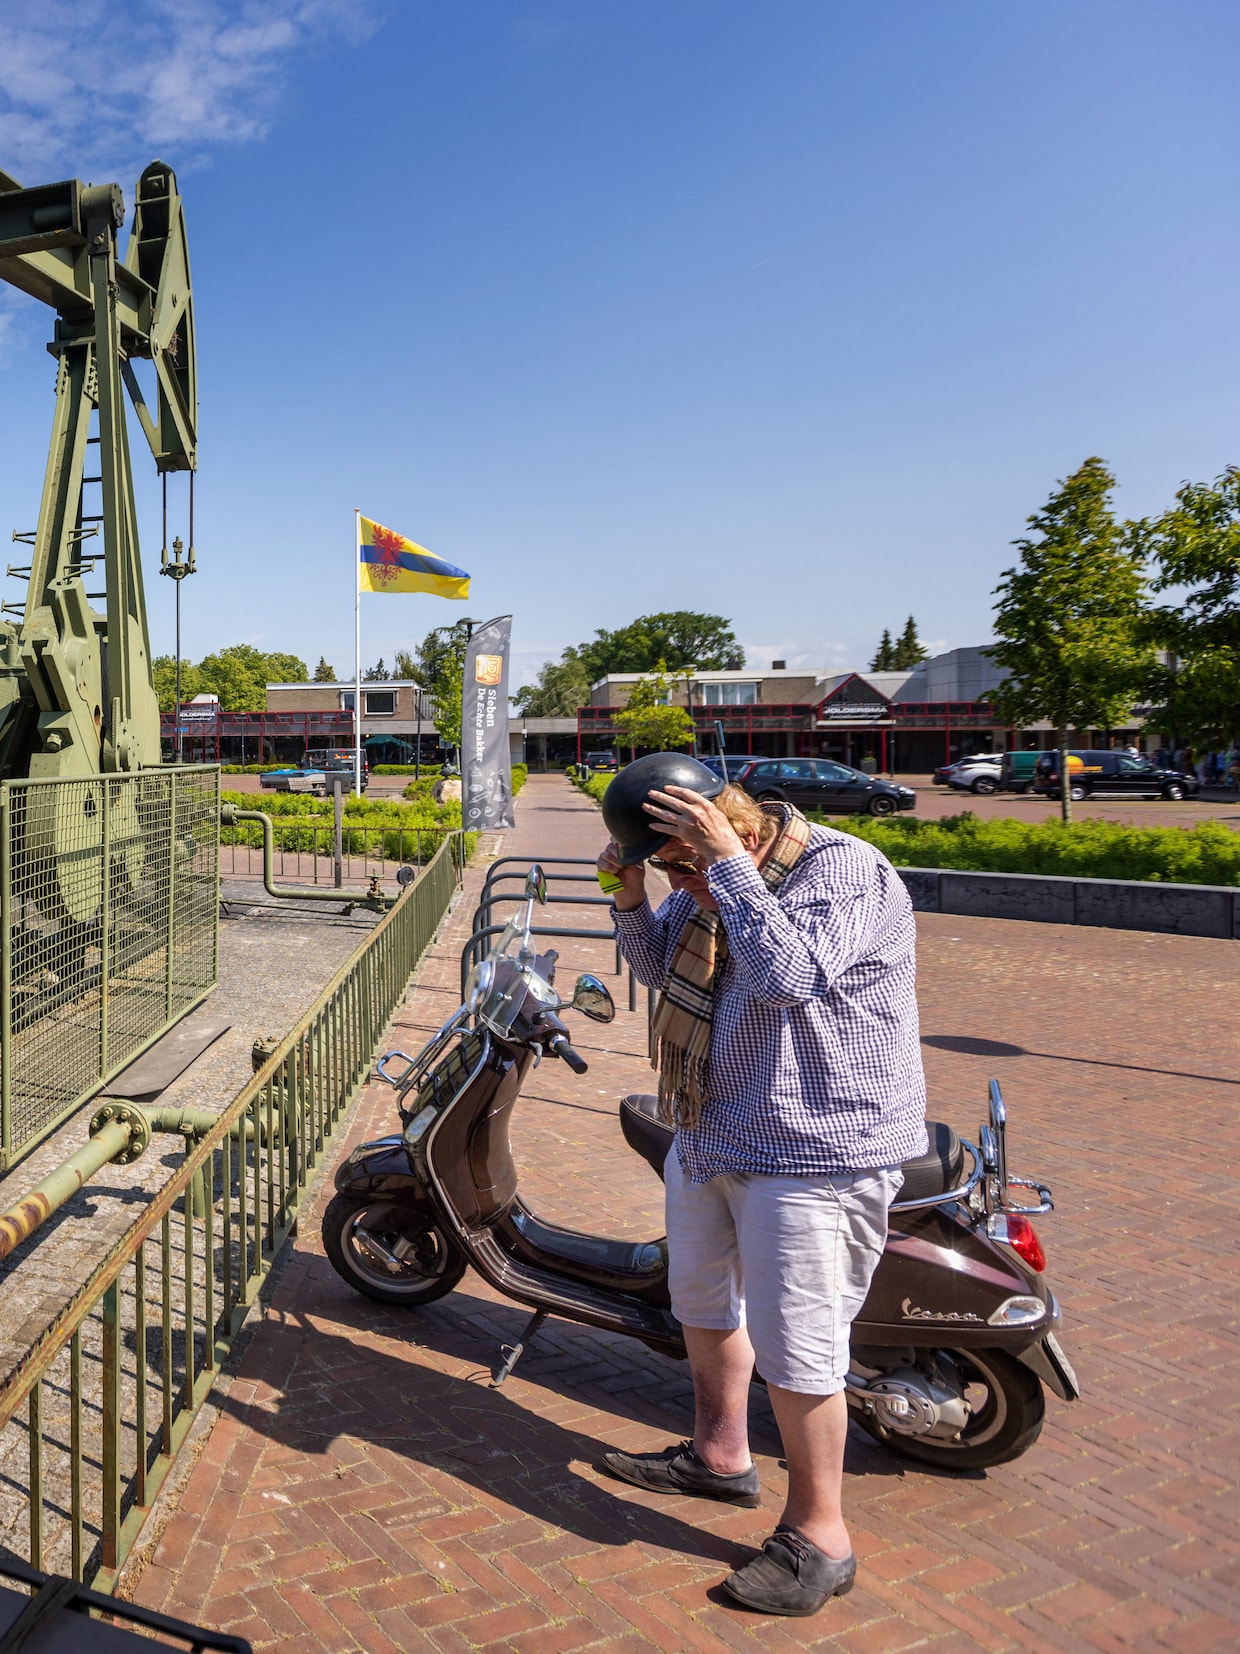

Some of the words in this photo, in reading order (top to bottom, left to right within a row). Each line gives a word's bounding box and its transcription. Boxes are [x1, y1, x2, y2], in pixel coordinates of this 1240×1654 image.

[477, 687, 486, 701] De
[475, 702, 485, 728] Echte
[486, 688, 497, 728] Sieben
[823, 706, 889, 714] JOLDERSMA
[475, 729, 486, 763] Bakker
[901, 1297, 984, 1322] Vespa
